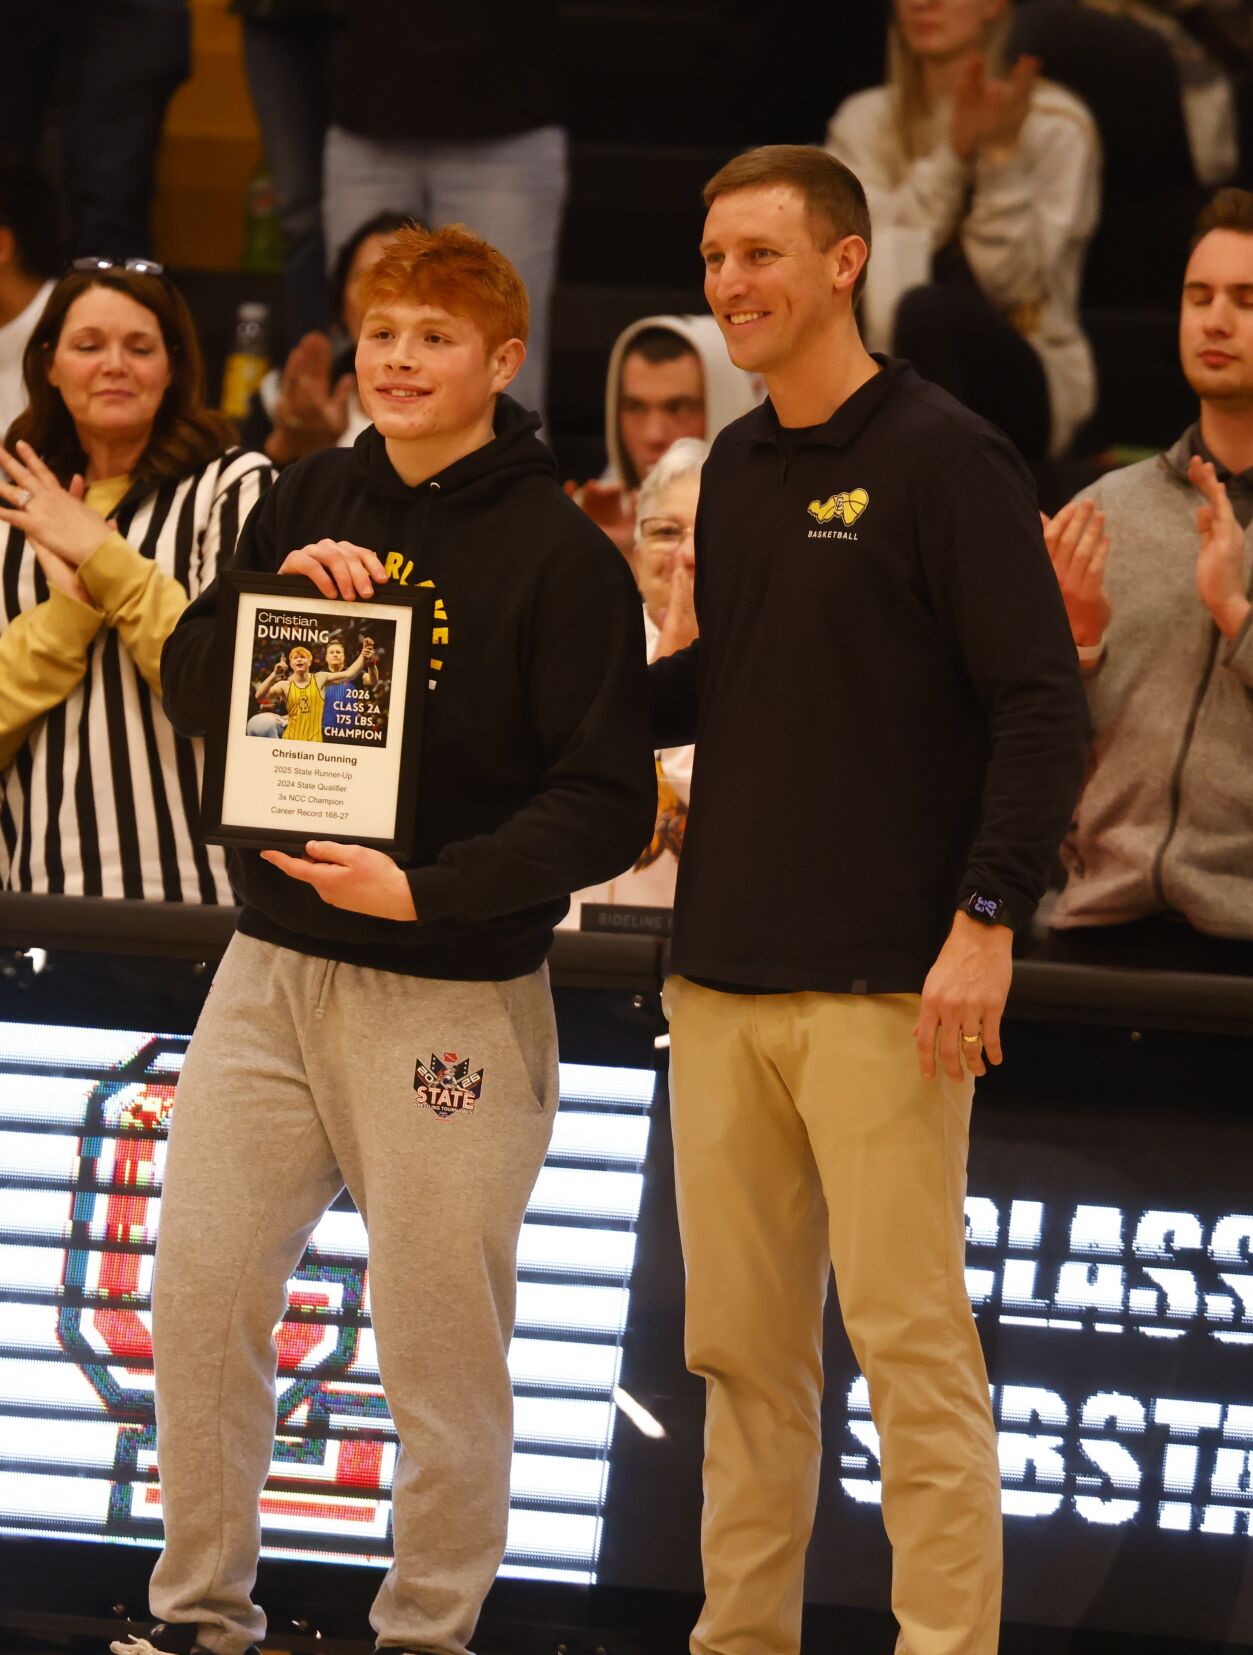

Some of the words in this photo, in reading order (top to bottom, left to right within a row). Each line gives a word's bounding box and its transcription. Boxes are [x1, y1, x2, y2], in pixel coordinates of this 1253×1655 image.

[807, 530, 859, 541] BASKETBALL
[258, 612, 318, 627] Christian
[257, 624, 329, 644] DUNNING
[345, 688, 370, 700] 2026
[333, 701, 364, 713] CLASS
[367, 703, 380, 714] 2A
[336, 714, 352, 724] 175
[354, 716, 375, 727] LBS.
[324, 726, 382, 740] CHAMPION
[272, 748, 315, 761] Christian
[317, 752, 358, 766] Dunning
[273, 766, 292, 774] 2025
[294, 767, 313, 776] State
[314, 769, 353, 780] Runner-Up
[277, 780, 295, 788] 2024
[297, 781, 315, 790] State
[317, 783, 347, 793] Qualifier
[278, 793, 287, 801] 3x
[288, 794, 306, 803] NCC
[308, 795, 344, 806] Champion
[271, 806, 296, 815] Career
[297, 808, 323, 818] Record
[325, 811, 349, 820] 168-27
[597, 911, 663, 929] SIDELINE
[417, 1065, 434, 1083] 20
[416, 1085, 476, 1111] STATE
